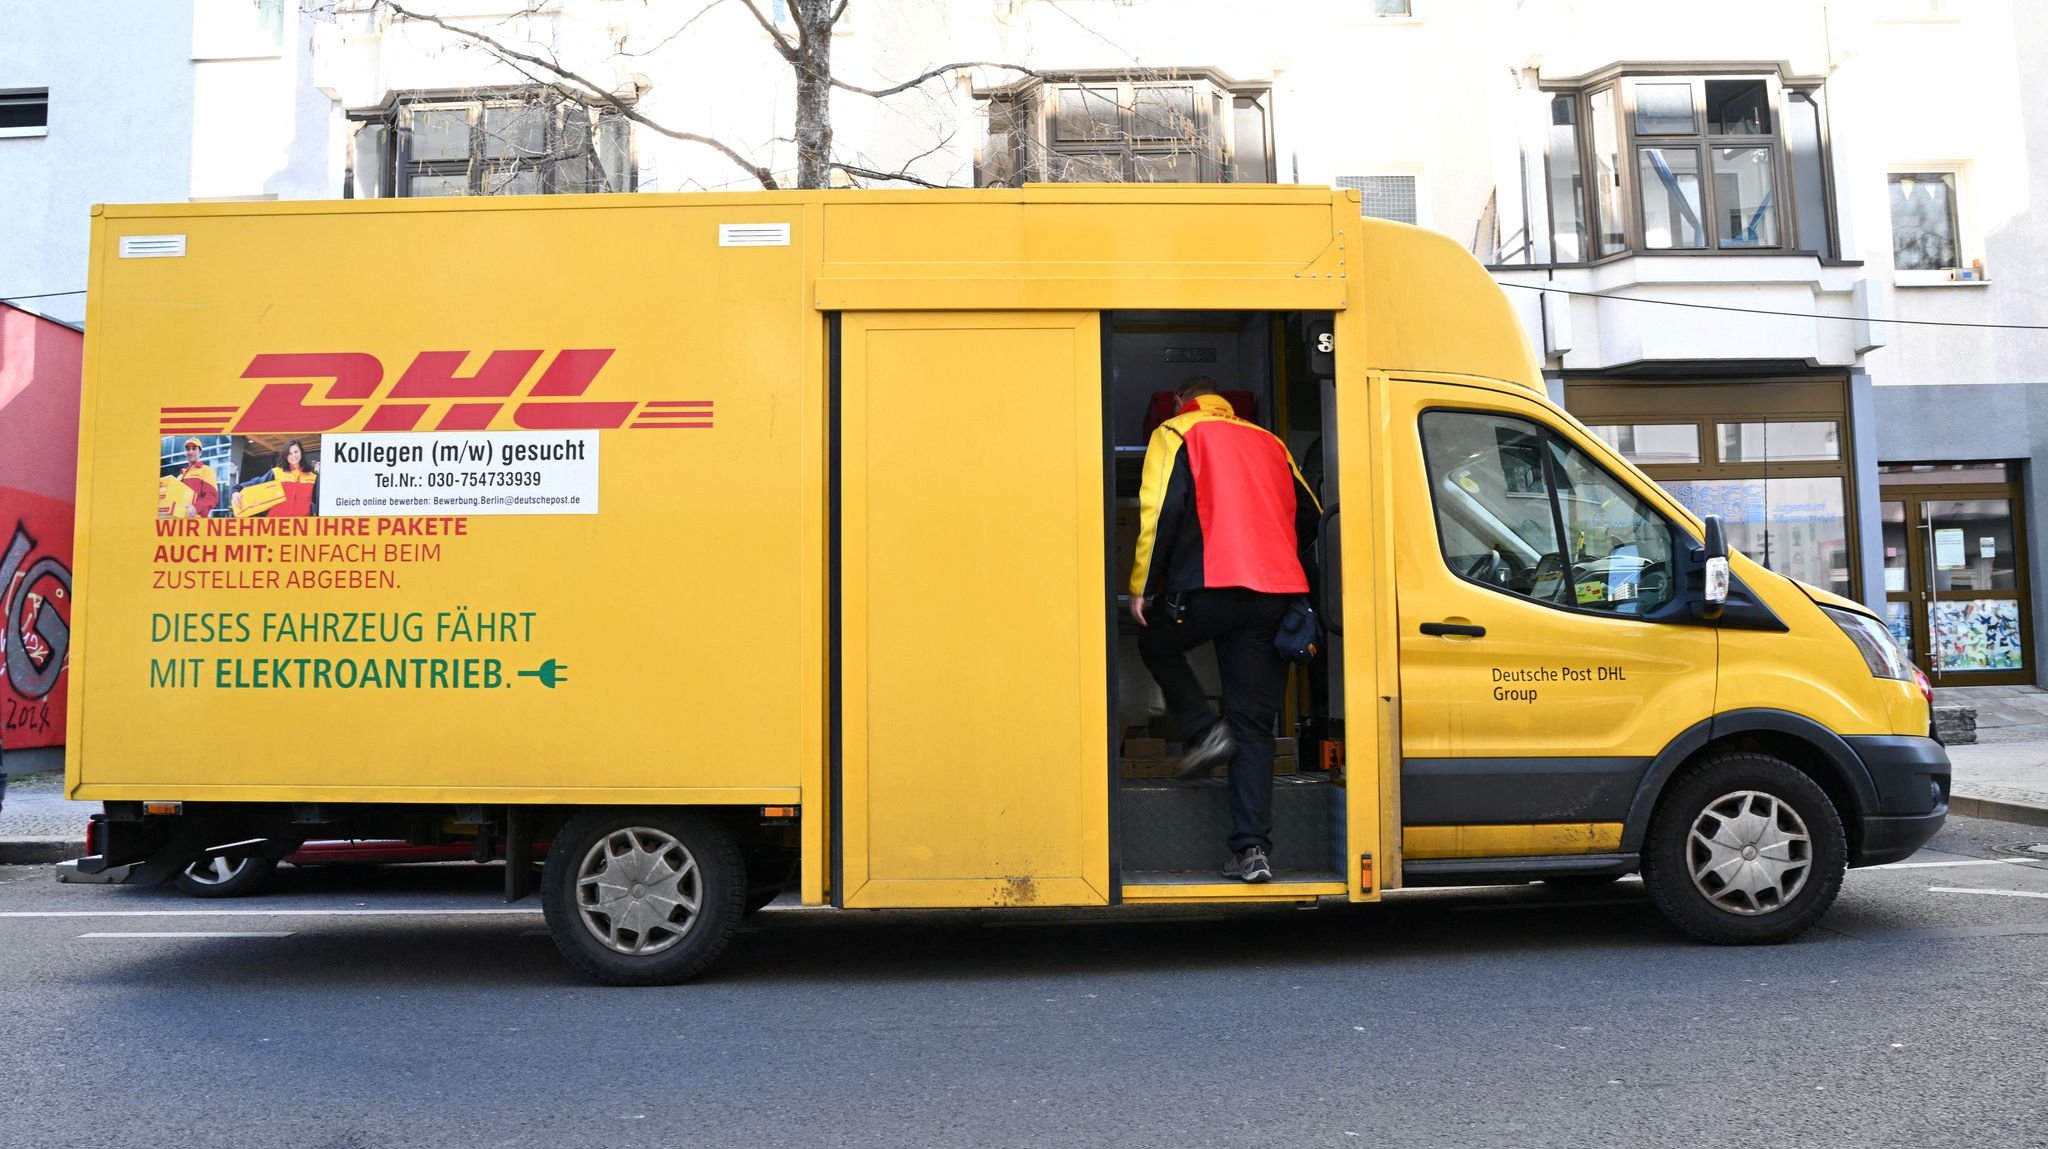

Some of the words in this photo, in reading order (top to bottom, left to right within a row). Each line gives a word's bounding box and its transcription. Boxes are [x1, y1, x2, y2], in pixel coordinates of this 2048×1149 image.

[231, 349, 639, 431] DHL
[335, 441, 423, 467] Kollegen
[432, 440, 493, 466] (m/w)
[502, 439, 585, 465] gesucht
[375, 472, 422, 488] Tel.Nr.:
[427, 471, 541, 488] 030-754733939
[336, 497, 361, 507] Gleich
[363, 497, 387, 506] online
[389, 496, 431, 506] bewerben:
[433, 495, 580, 507] Bewerbung.Berlin@deutschepost.de
[155, 518, 200, 537] WIR
[207, 518, 309, 537] NEHMEN
[315, 517, 370, 536] IHRE
[377, 517, 467, 536] PAKETE
[153, 544, 217, 563] AUCH
[225, 544, 273, 563] MIT:
[280, 543, 376, 562] EINFACH
[384, 543, 441, 562] BEIM
[152, 570, 280, 589] ZUSTELLER
[286, 569, 401, 589] ABGEBEN.
[151, 612, 250, 643] DIESES
[262, 611, 423, 643] FAHRZEUG
[436, 605, 537, 642] FÄHRT
[150, 658, 205, 689] MIT
[215, 657, 512, 689] ELEKTROANTRIEB.
[1492, 667, 1558, 682] Deutsche
[1562, 667, 1592, 681] Post
[1597, 666, 1626, 681] DHL
[1493, 686, 1537, 704] Group
